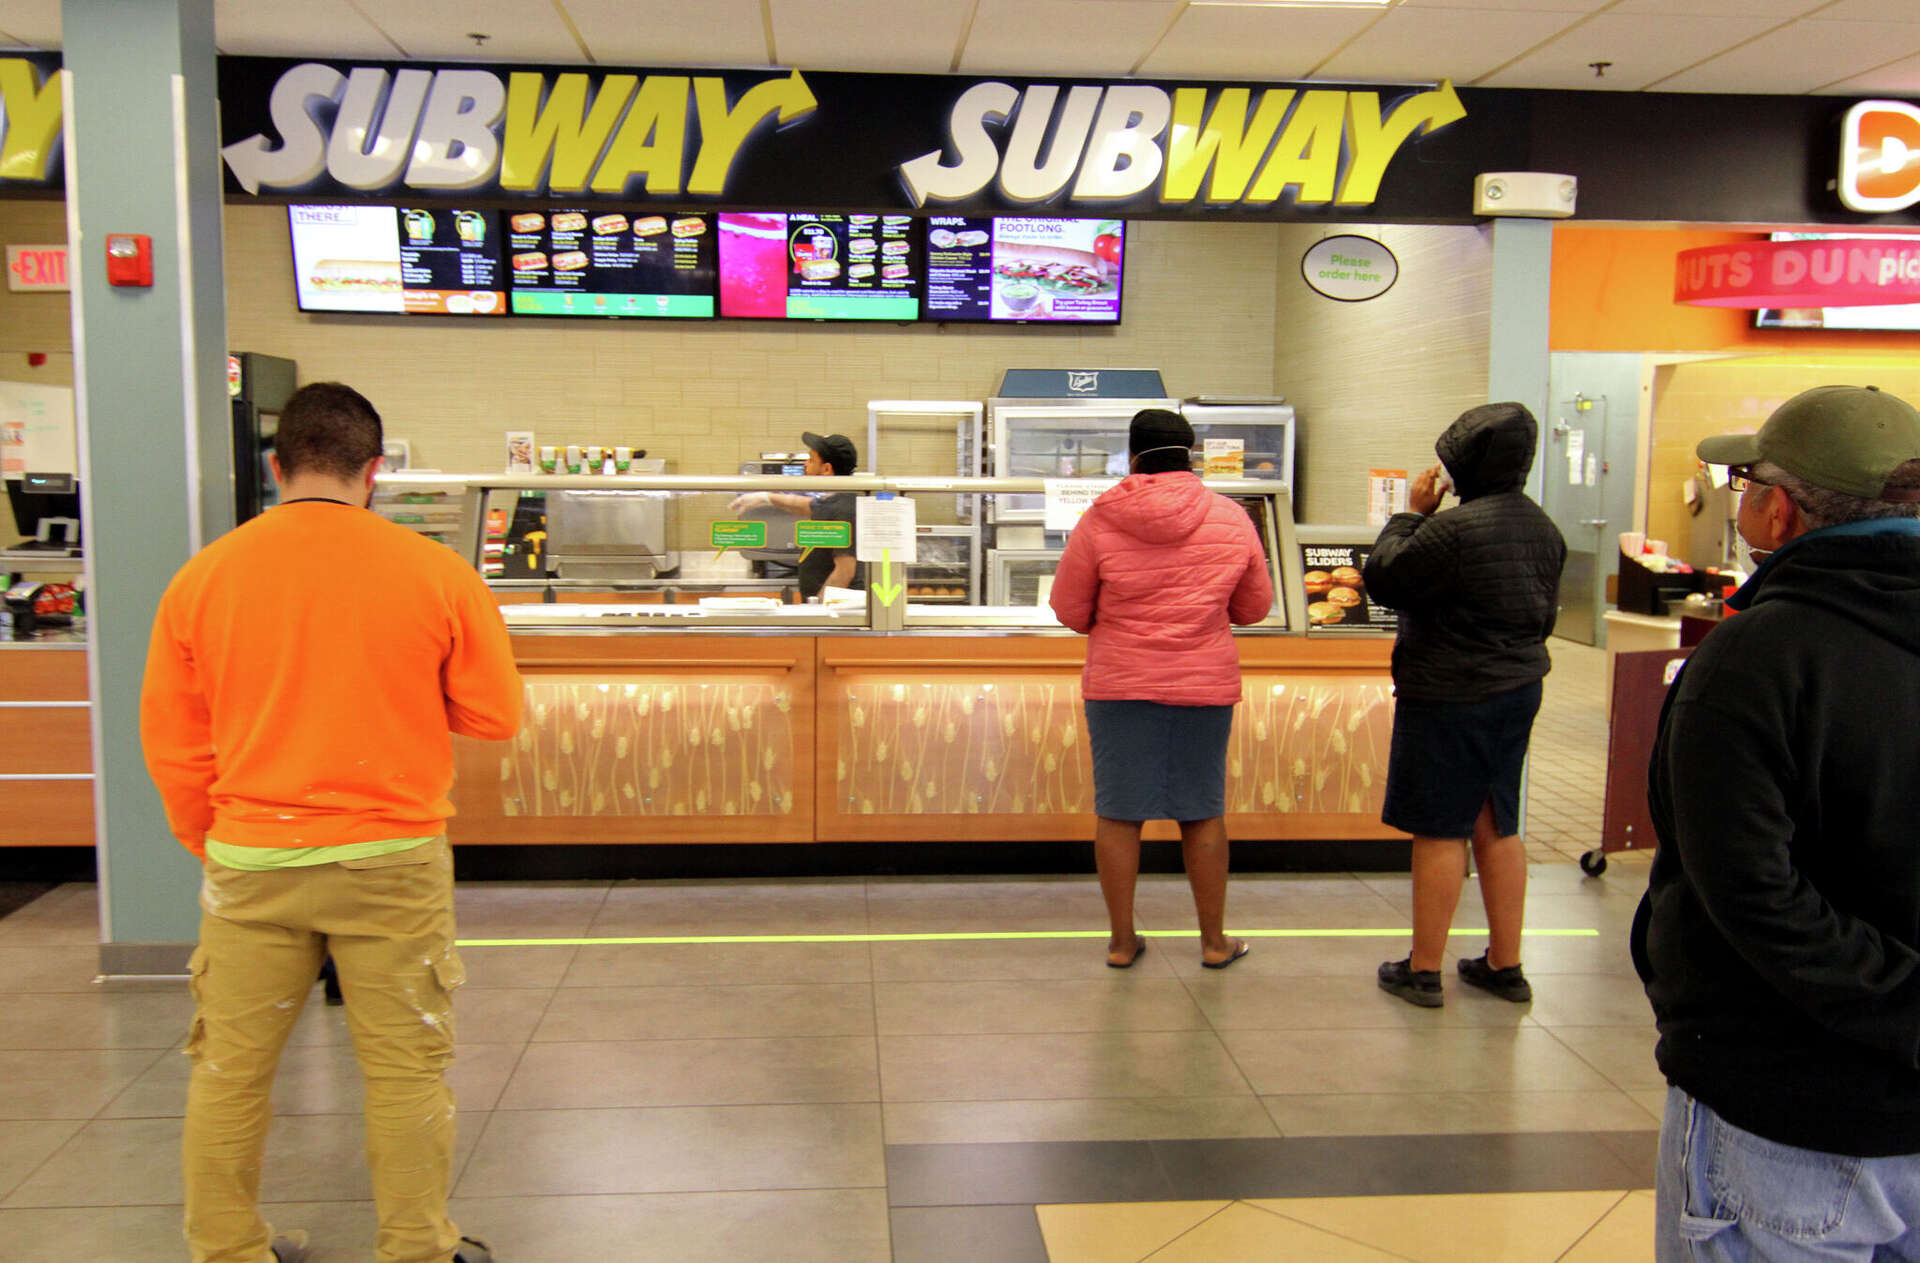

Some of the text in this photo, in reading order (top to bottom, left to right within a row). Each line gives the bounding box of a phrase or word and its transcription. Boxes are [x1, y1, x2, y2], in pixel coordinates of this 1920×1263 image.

[222, 62, 818, 197] SUBWAY
[900, 79, 1467, 208] SUBWAY
[18, 250, 67, 285] EXIT
[1330, 253, 1372, 268] Please
[1318, 269, 1382, 283] order here
[1305, 548, 1353, 558] SUBWAY
[1306, 557, 1353, 567] SLIDERS
